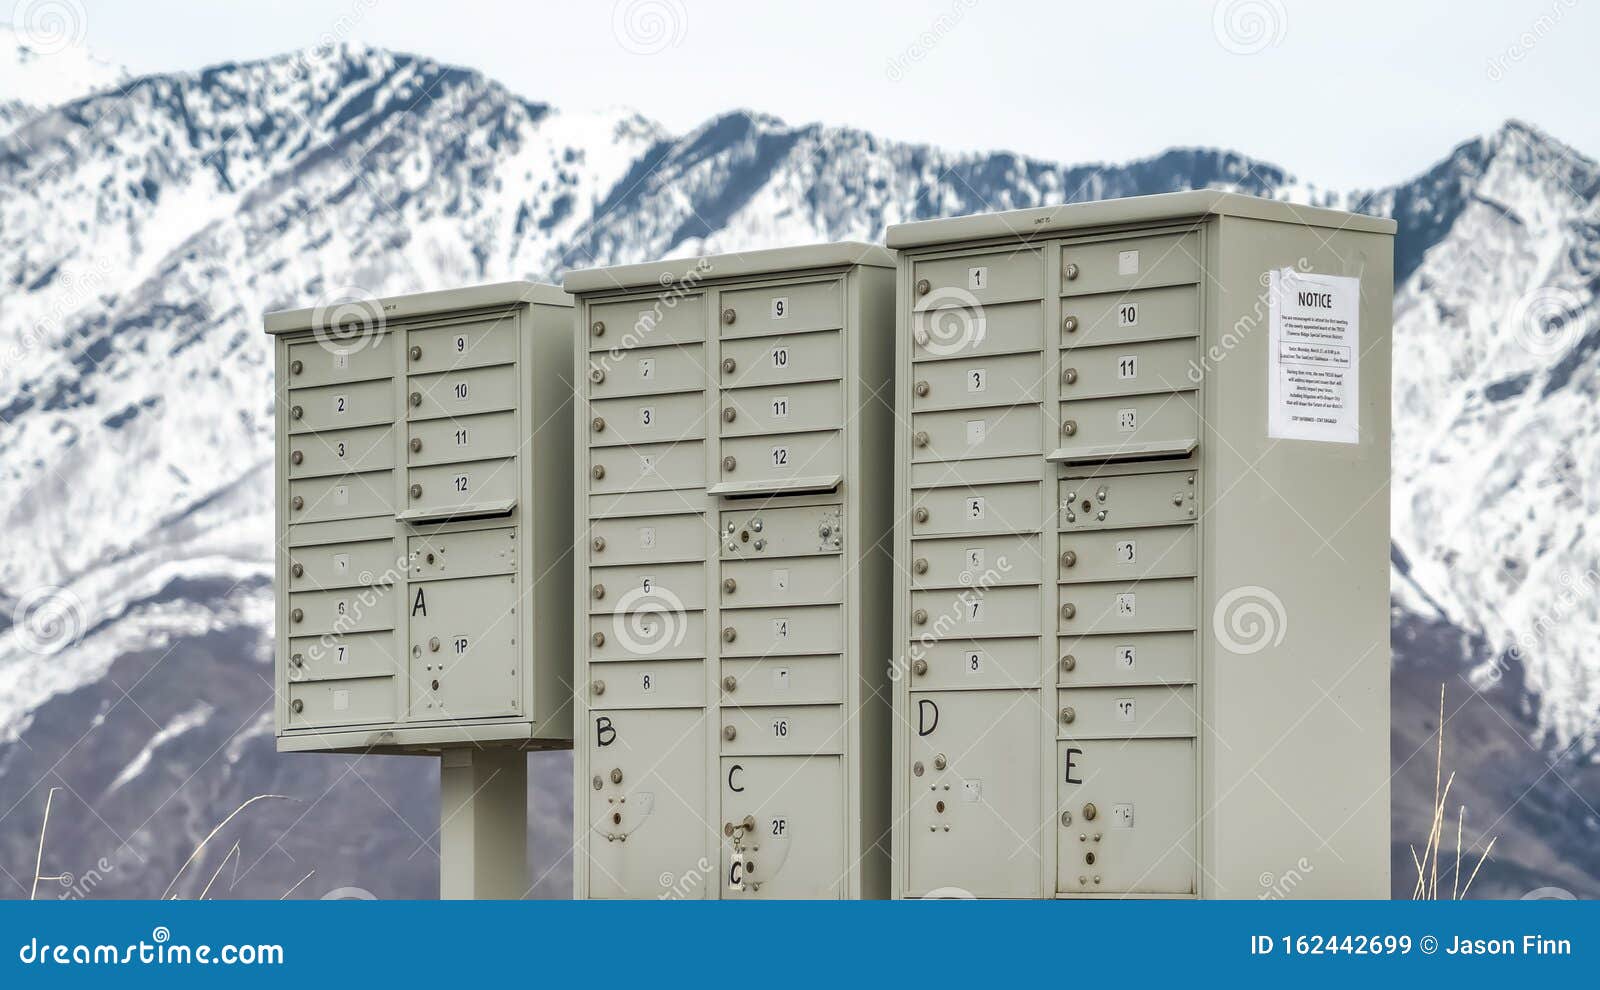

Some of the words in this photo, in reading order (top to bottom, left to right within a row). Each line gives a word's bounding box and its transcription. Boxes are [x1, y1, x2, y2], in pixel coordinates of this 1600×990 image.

[974, 270, 981, 286] 1
[1298, 291, 1332, 309] NOTICE
[776, 300, 784, 317] 9
[1120, 306, 1136, 324] 10
[457, 337, 464, 352] 9
[773, 350, 787, 366] 10
[1120, 359, 1134, 377] 11
[972, 372, 981, 389] 3
[454, 383, 467, 399] 10
[337, 397, 345, 412] 2
[773, 401, 786, 415] 11
[643, 409, 651, 425] 3
[455, 429, 467, 445] 11
[338, 442, 345, 458] 3
[773, 449, 787, 465] 12
[455, 476, 468, 492] 12
[972, 500, 980, 517] 5
[643, 578, 651, 594] 6
[412, 587, 427, 617] A
[338, 647, 345, 662] 7
[454, 639, 468, 654] 1P
[970, 654, 979, 671] 8
[643, 674, 651, 690] 8
[918, 699, 939, 737] D
[595, 716, 617, 748] B
[773, 721, 787, 737] 16
[1065, 748, 1083, 785] E
[728, 764, 745, 793] C
[730, 861, 742, 885] C
